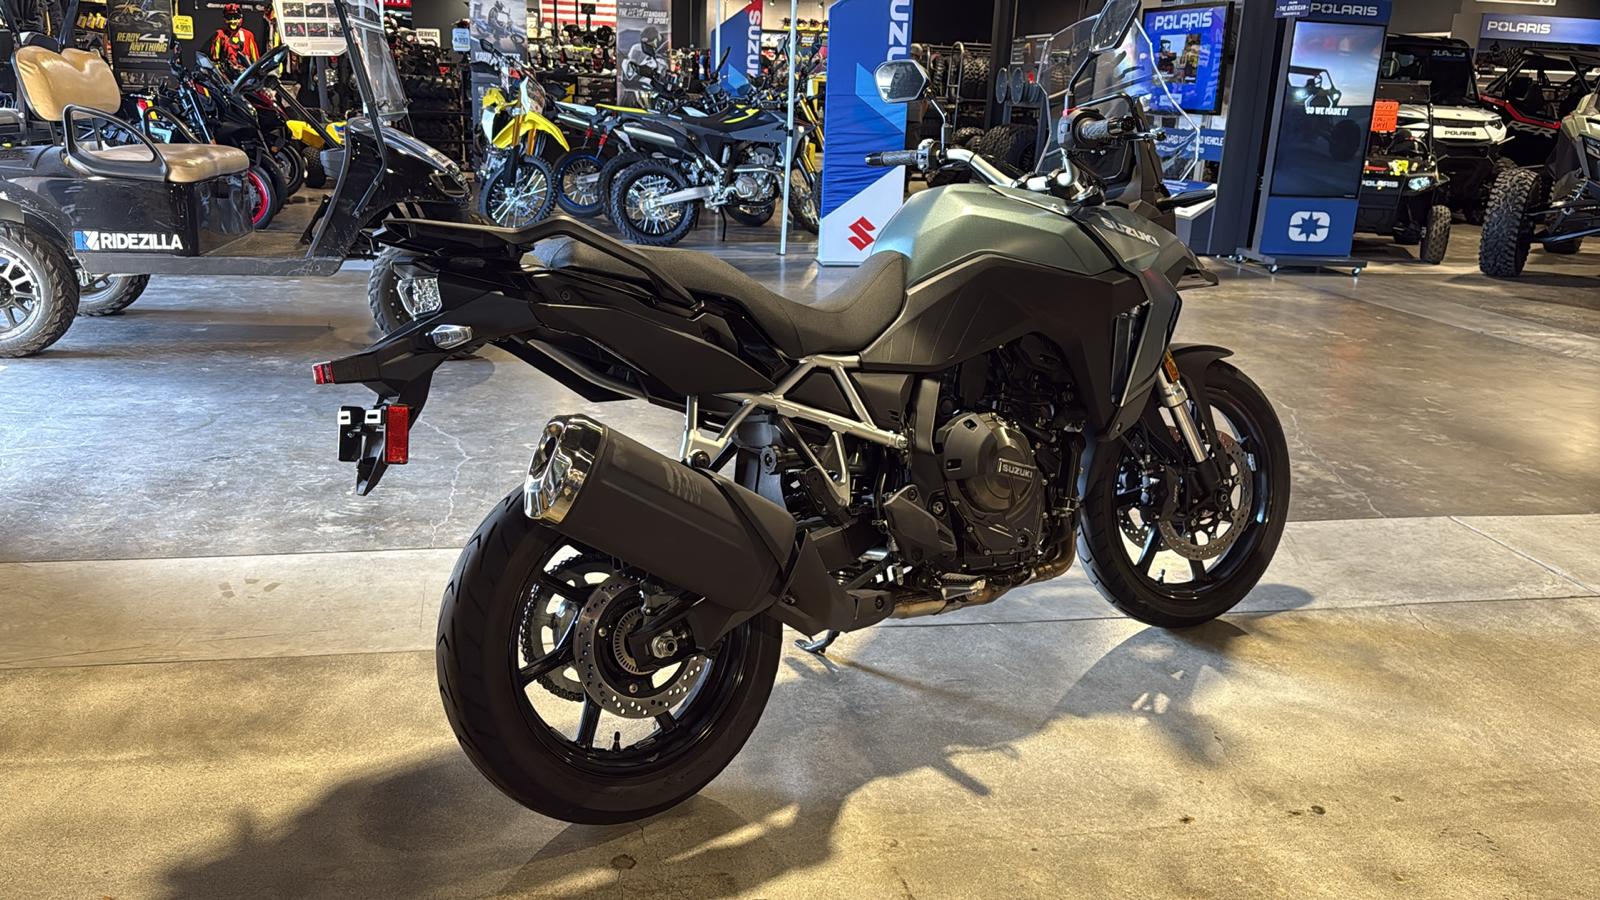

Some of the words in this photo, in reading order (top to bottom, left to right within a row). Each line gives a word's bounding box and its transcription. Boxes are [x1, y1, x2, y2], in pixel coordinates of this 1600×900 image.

[1310, 3, 1378, 16] POLARIS
[1154, 11, 1213, 31] POLARIS
[1487, 21, 1551, 34] POLARIS
[116, 32, 140, 42] READY
[129, 41, 168, 53] ANYTHING
[1306, 107, 1314, 115] SO
[1315, 107, 1325, 115] WE
[1325, 108, 1341, 116] MADE
[1341, 108, 1349, 116] IT
[1506, 120, 1557, 138] RZR
[1361, 180, 1399, 188] POLARIS
[1100, 217, 1160, 247] SUZUKI
[100, 233, 184, 250] RIDEZILLA
[1002, 464, 1033, 478] SUZUKI
